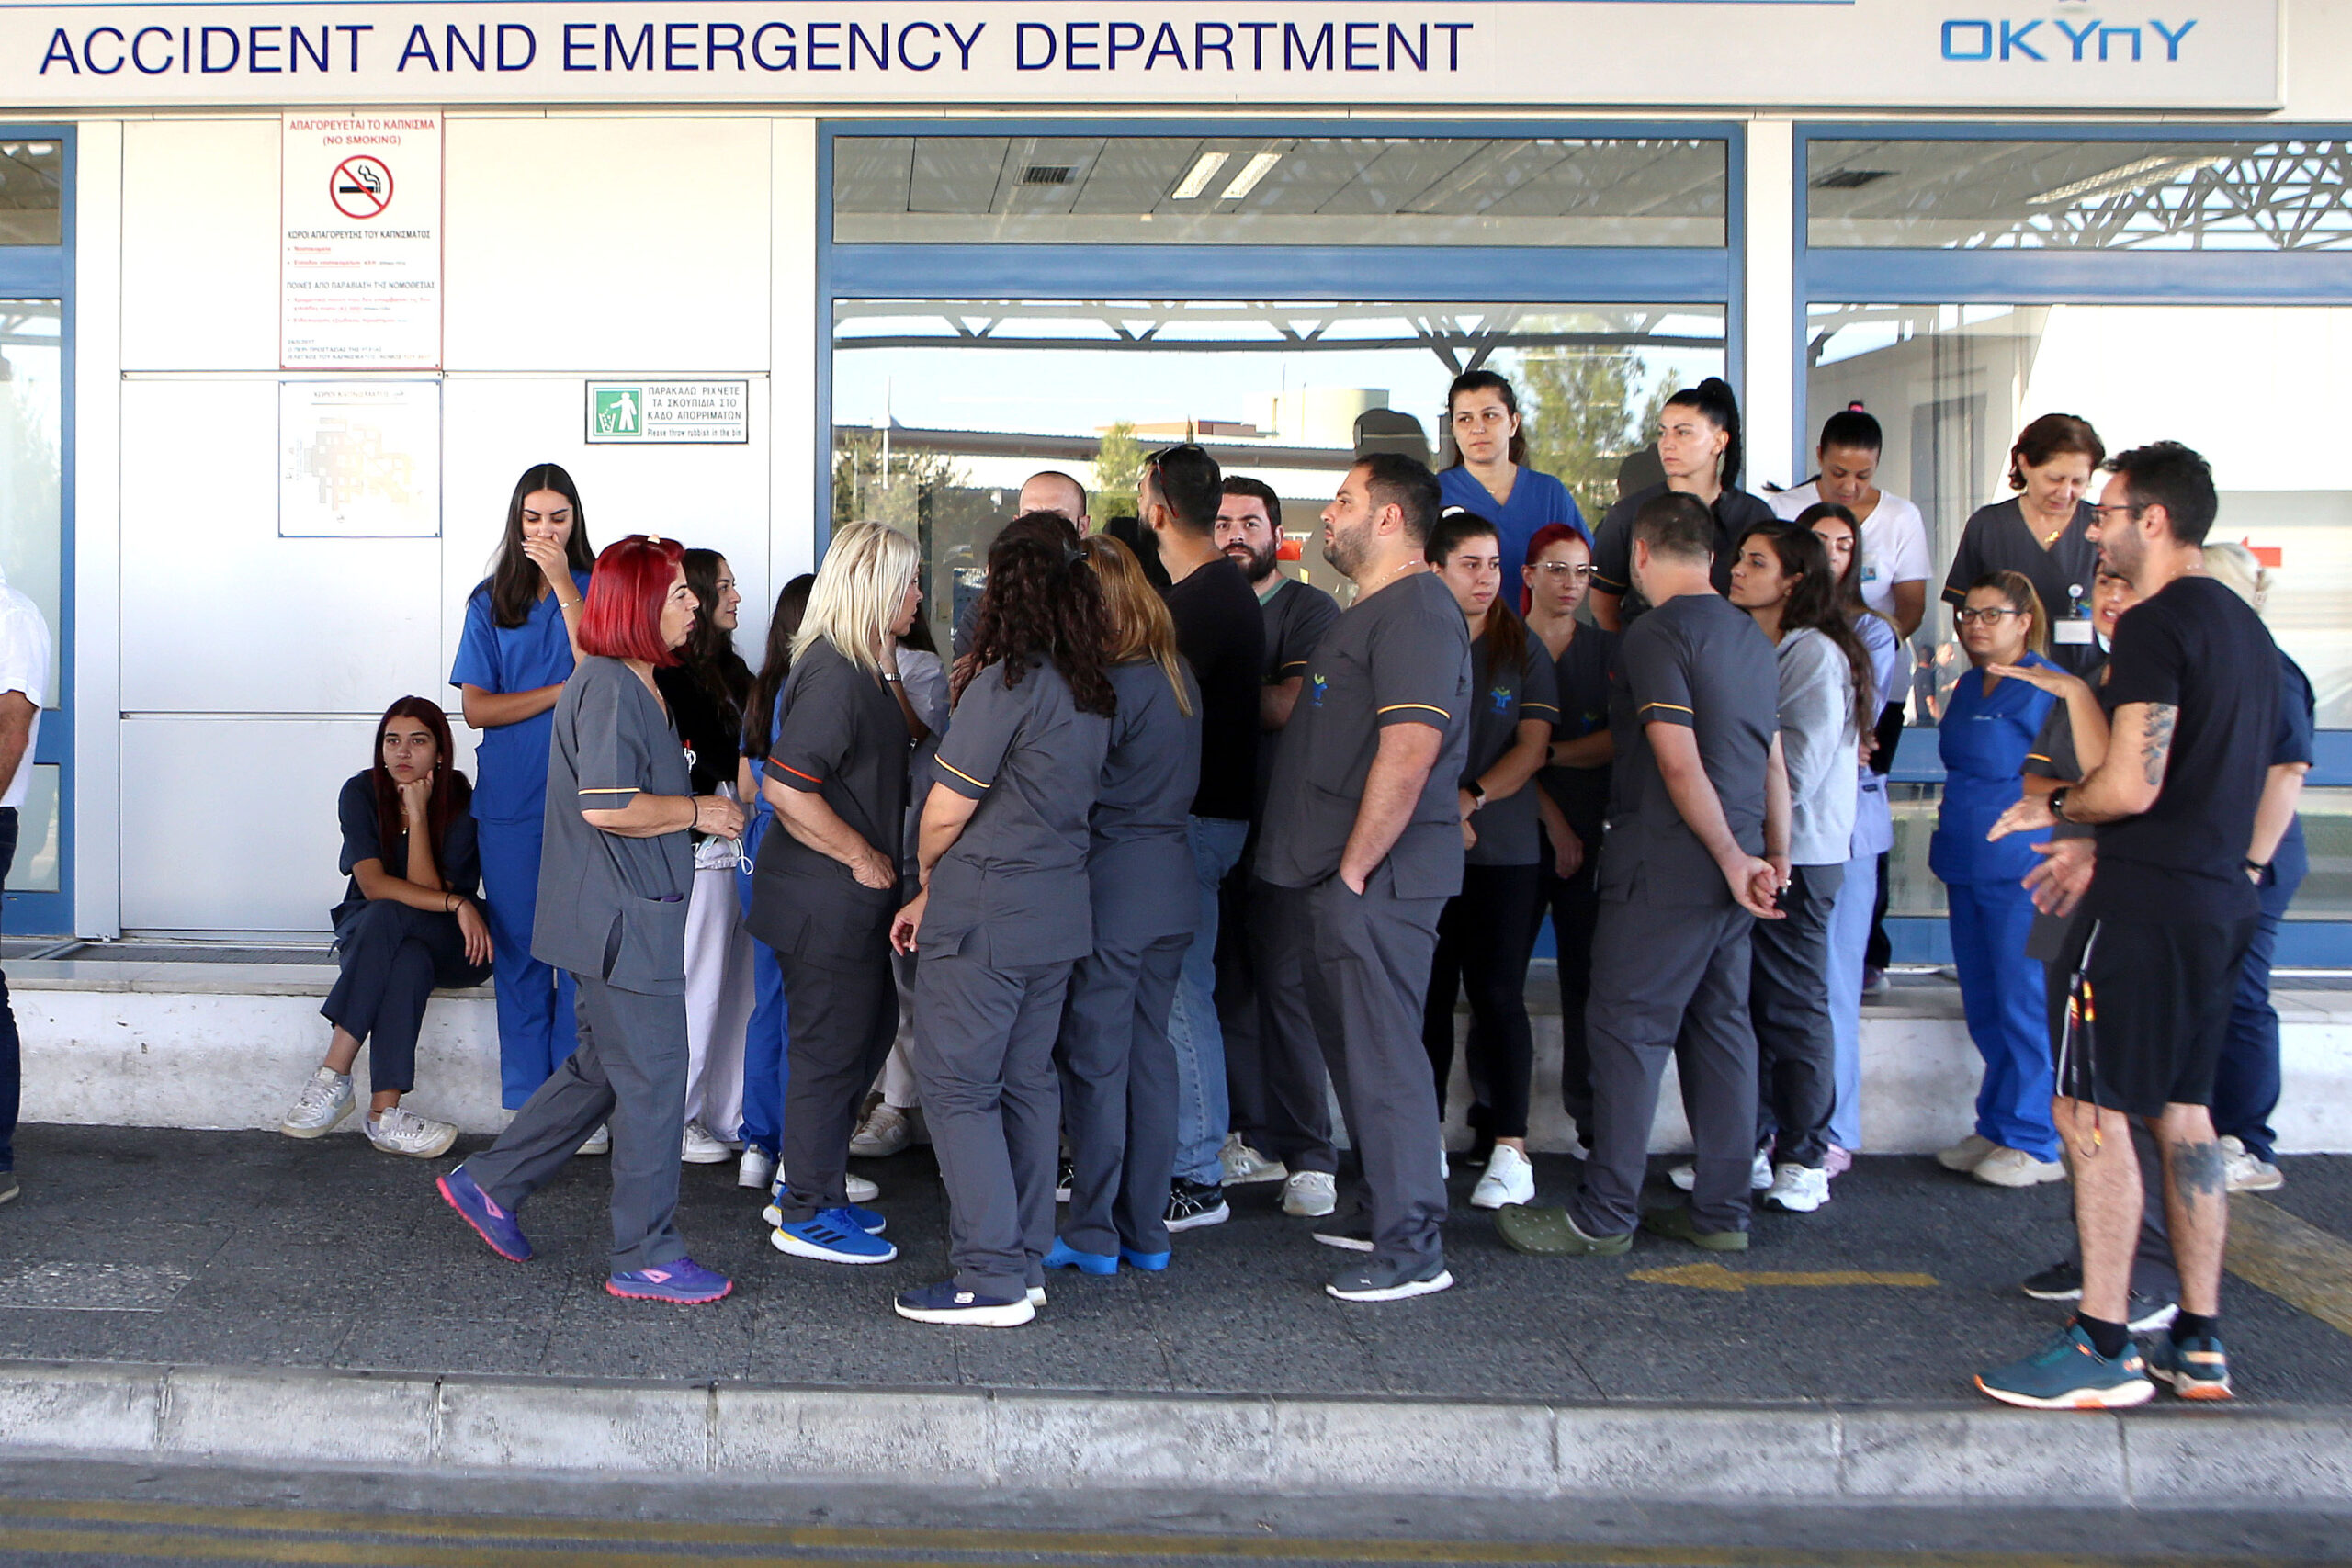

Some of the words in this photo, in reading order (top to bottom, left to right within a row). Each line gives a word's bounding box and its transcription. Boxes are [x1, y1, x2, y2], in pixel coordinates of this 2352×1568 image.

[39, 25, 375, 76] ACCIDENT
[396, 23, 537, 73] AND
[562, 21, 987, 73] EMERGENCY
[1015, 22, 1475, 73] DEPARTMENT
[289, 119, 366, 131] ΑΠΑΓΟΡΕΥΕΤΑΙ
[368, 119, 381, 130] ΤΟ
[383, 118, 435, 130] ΚΑΠΝΙΣΜΑ
[322, 135, 344, 147] (NO
[345, 135, 401, 147] SMOKING)
[287, 230, 310, 240] ΧΩΡΟΙ
[311, 230, 363, 240] ΑΠΑΓΟΡΕΥΣΗΣ
[364, 230, 379, 240] ΤΟΥ
[379, 230, 431, 240] ΚΑΠΝΙΣΜΑΤΟΣ
[314, 281, 330, 290] ΑΠΟ
[374, 281, 387, 289] ΤΗΣ
[648, 386, 697, 396] ΠΑΡΑΚΑΛΩ
[702, 386, 741, 396] ΡΙΧΝΕΤΕ
[652, 398, 663, 408] ΤΑ
[667, 398, 716, 408] ΣΚΟΥΠΙΔΙΑ
[719, 398, 738, 408] ΣΤΟ
[647, 411, 673, 421] ΚΑΔΟ
[677, 411, 742, 421] ΑΠΟΡΡΙΜΑΤΩΝ
[647, 427, 667, 438] Please
[669, 427, 685, 438] throw
[687, 427, 710, 438] rubbish
[711, 428, 718, 437] in
[719, 427, 729, 437] the
[731, 428, 741, 437] bin
